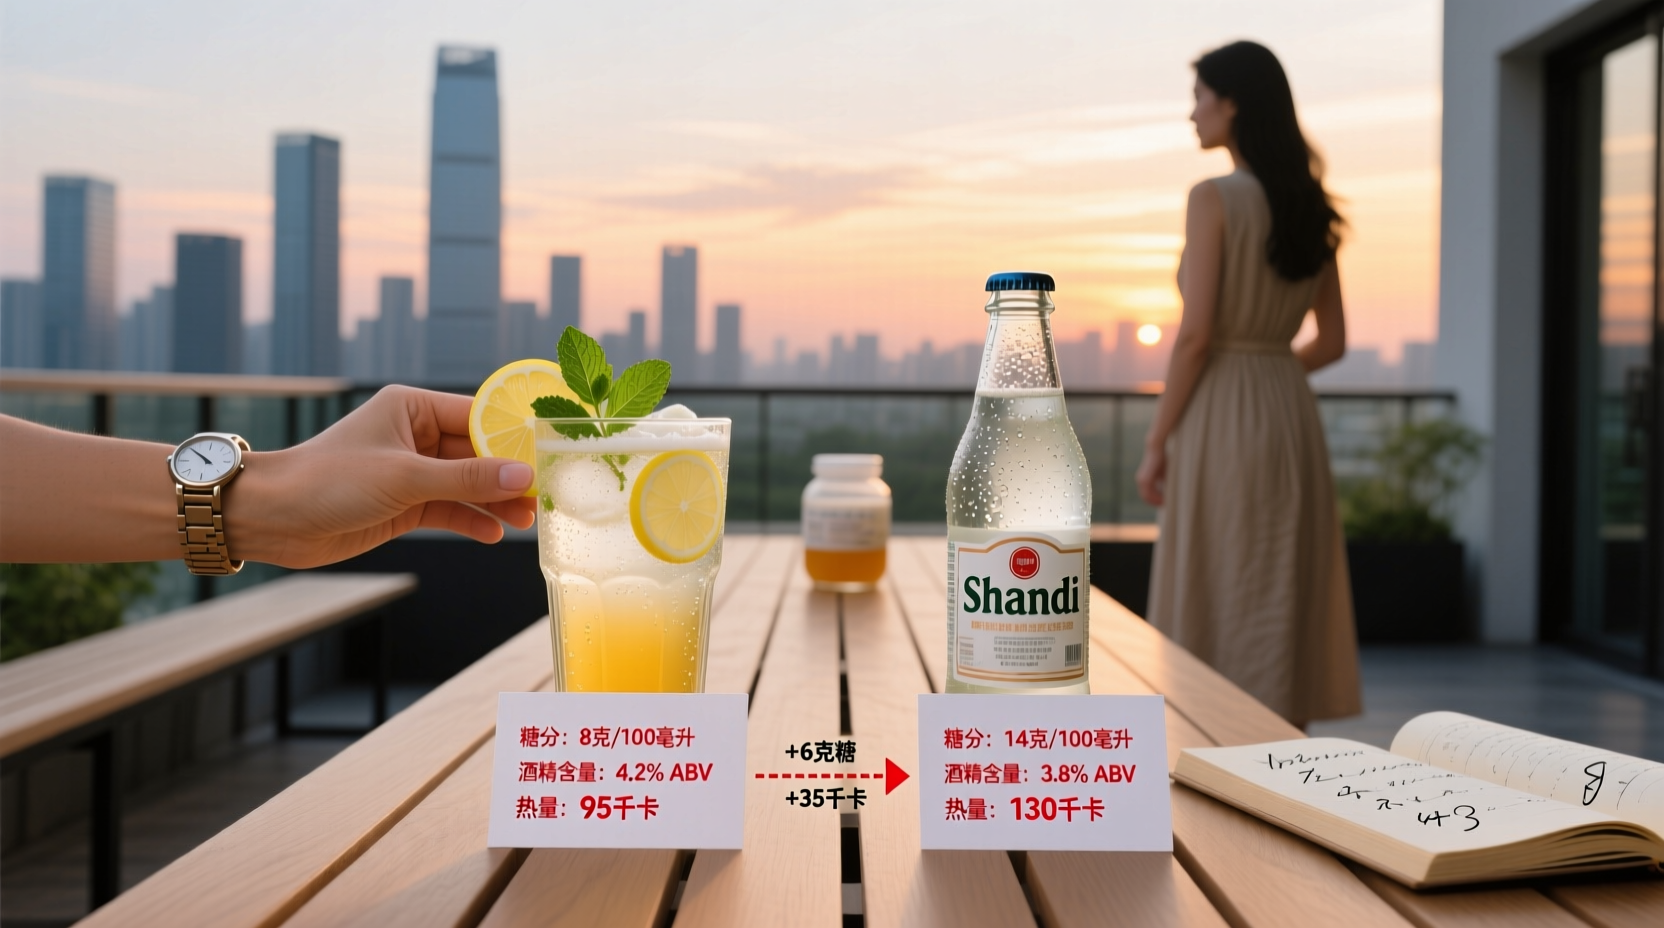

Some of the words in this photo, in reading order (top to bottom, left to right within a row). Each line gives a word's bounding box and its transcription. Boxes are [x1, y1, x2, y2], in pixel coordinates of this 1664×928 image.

[963, 575, 1080, 616] Shandi
[669, 762, 714, 782] ABV
[1093, 763, 1137, 783] ABV
